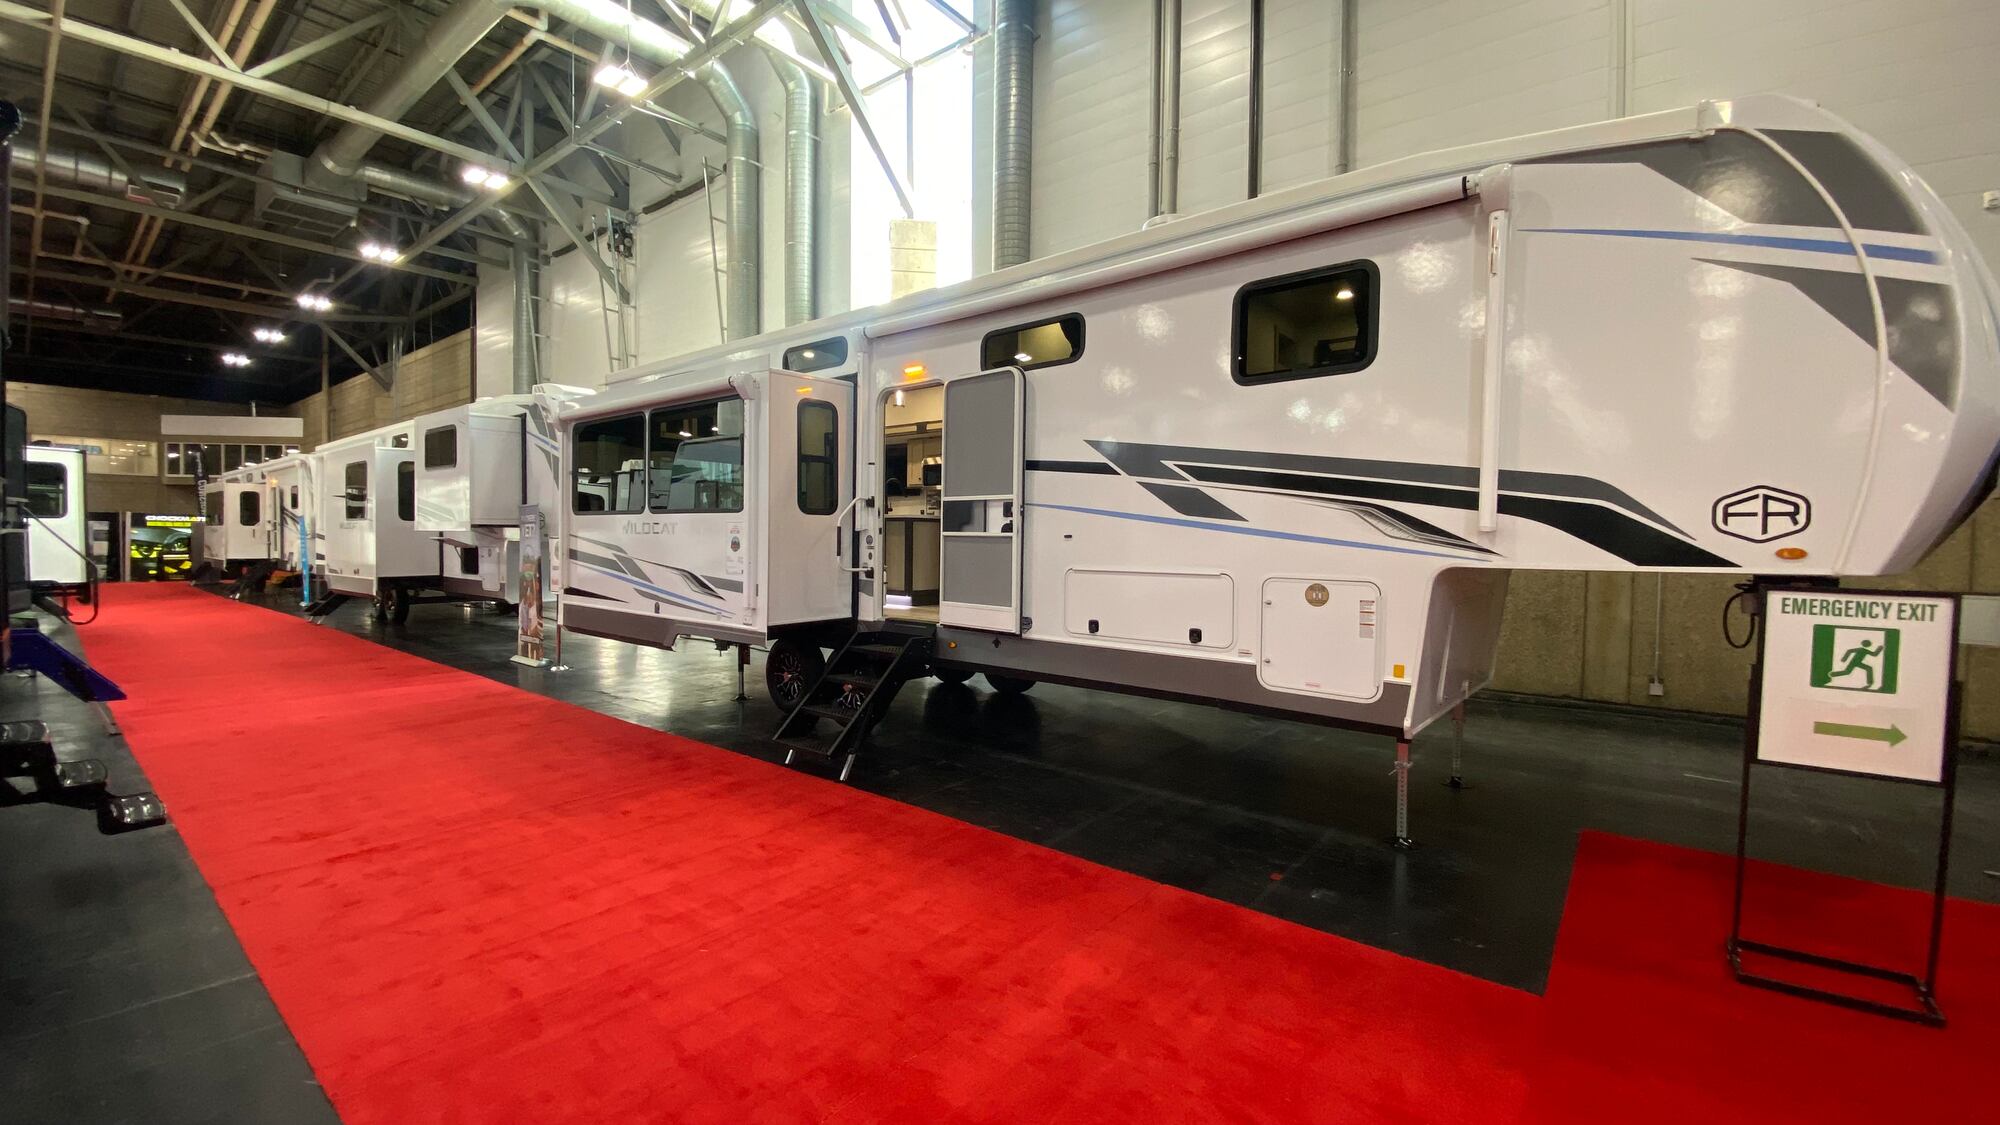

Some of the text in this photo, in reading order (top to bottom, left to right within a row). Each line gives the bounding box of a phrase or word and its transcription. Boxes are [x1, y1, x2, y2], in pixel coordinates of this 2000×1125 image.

[1723, 493, 1800, 535] FR
[623, 520, 678, 534] WILDCAT
[1781, 597, 1939, 622] EMERGENCY EXIT
